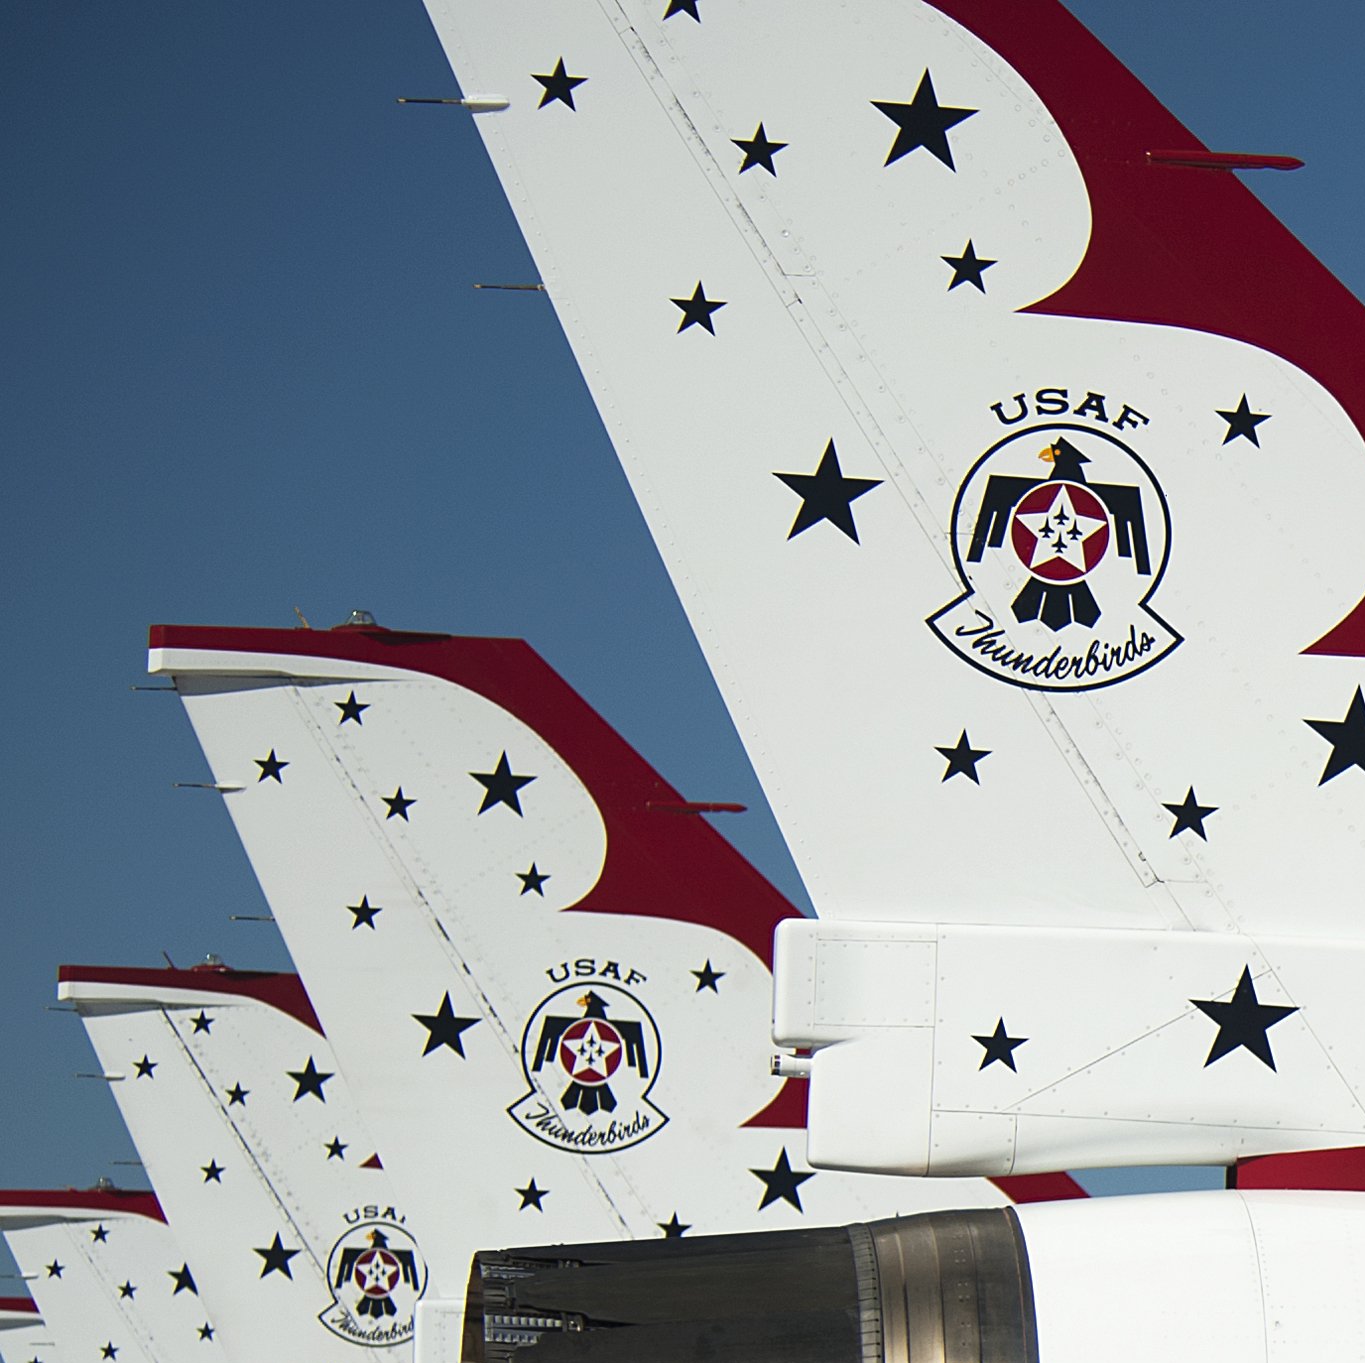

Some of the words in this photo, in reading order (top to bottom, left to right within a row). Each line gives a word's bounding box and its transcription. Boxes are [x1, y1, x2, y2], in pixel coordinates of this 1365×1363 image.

[990, 388, 1150, 431] USAF
[955, 609, 1156, 681] Thunderbirds
[546, 958, 647, 986] USAF
[524, 1102, 649, 1147] Thunderbirds
[343, 1205, 406, 1224] USA
[331, 1310, 414, 1342] Thunderbird
